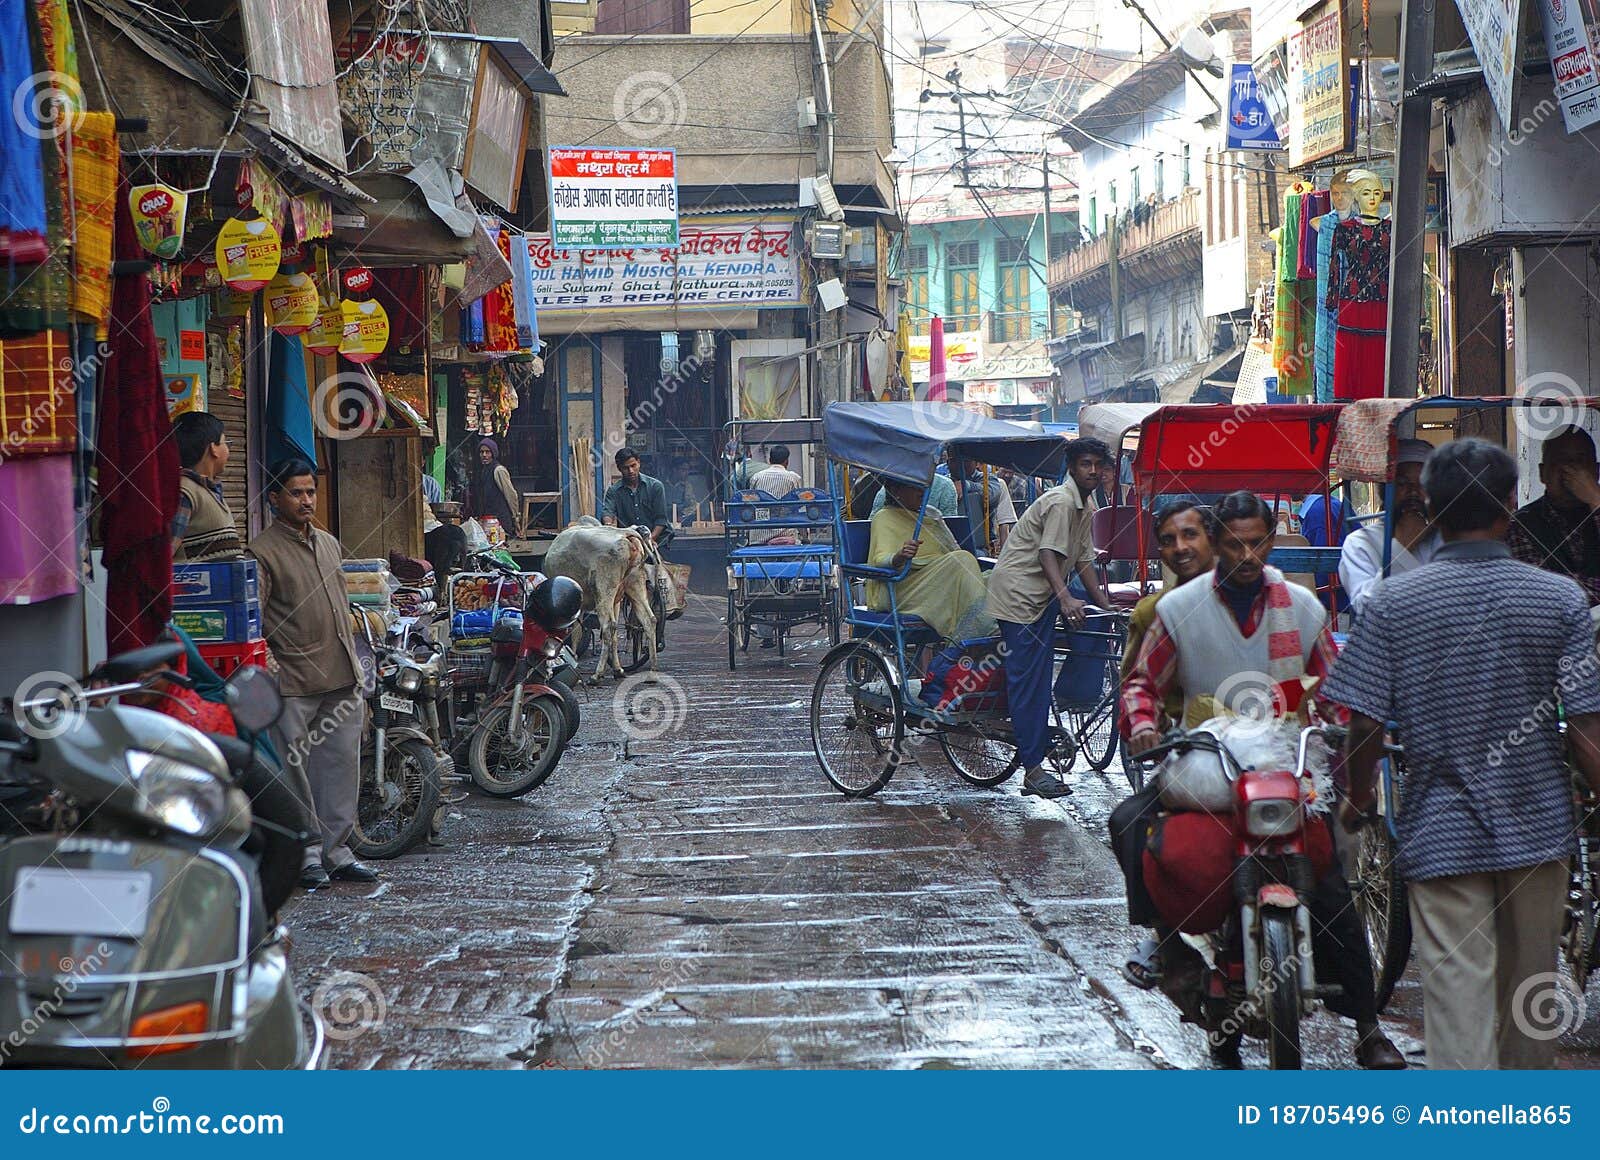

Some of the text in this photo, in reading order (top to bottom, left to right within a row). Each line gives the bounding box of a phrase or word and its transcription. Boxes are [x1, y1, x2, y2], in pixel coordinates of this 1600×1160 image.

[1555, 51, 1590, 78] KOTHARI
[576, 160, 650, 177] मथुरा शहर में
[141, 193, 168, 213] CRAX
[583, 188, 612, 208] आपका
[615, 188, 645, 208] स्वागत
[646, 184, 667, 208] करती
[666, 184, 675, 211] है
[248, 243, 278, 260] FREE
[281, 246, 301, 257] RAX
[527, 238, 570, 268] ब्दुल
[747, 225, 790, 258] केन्द्र
[346, 271, 370, 288] CRAX
[532, 269, 556, 280] DUL
[561, 266, 614, 280] HAMID
[622, 263, 697, 279] MUSICAL
[554, 282, 613, 293] Swami
[622, 280, 661, 292] Ghat
[289, 295, 316, 308] FREE
[534, 295, 588, 304] LES
[599, 294, 613, 303] &
[623, 290, 708, 302] REPAIRE
[361, 322, 386, 336] FREE
[173, 572, 202, 583] EPSI
